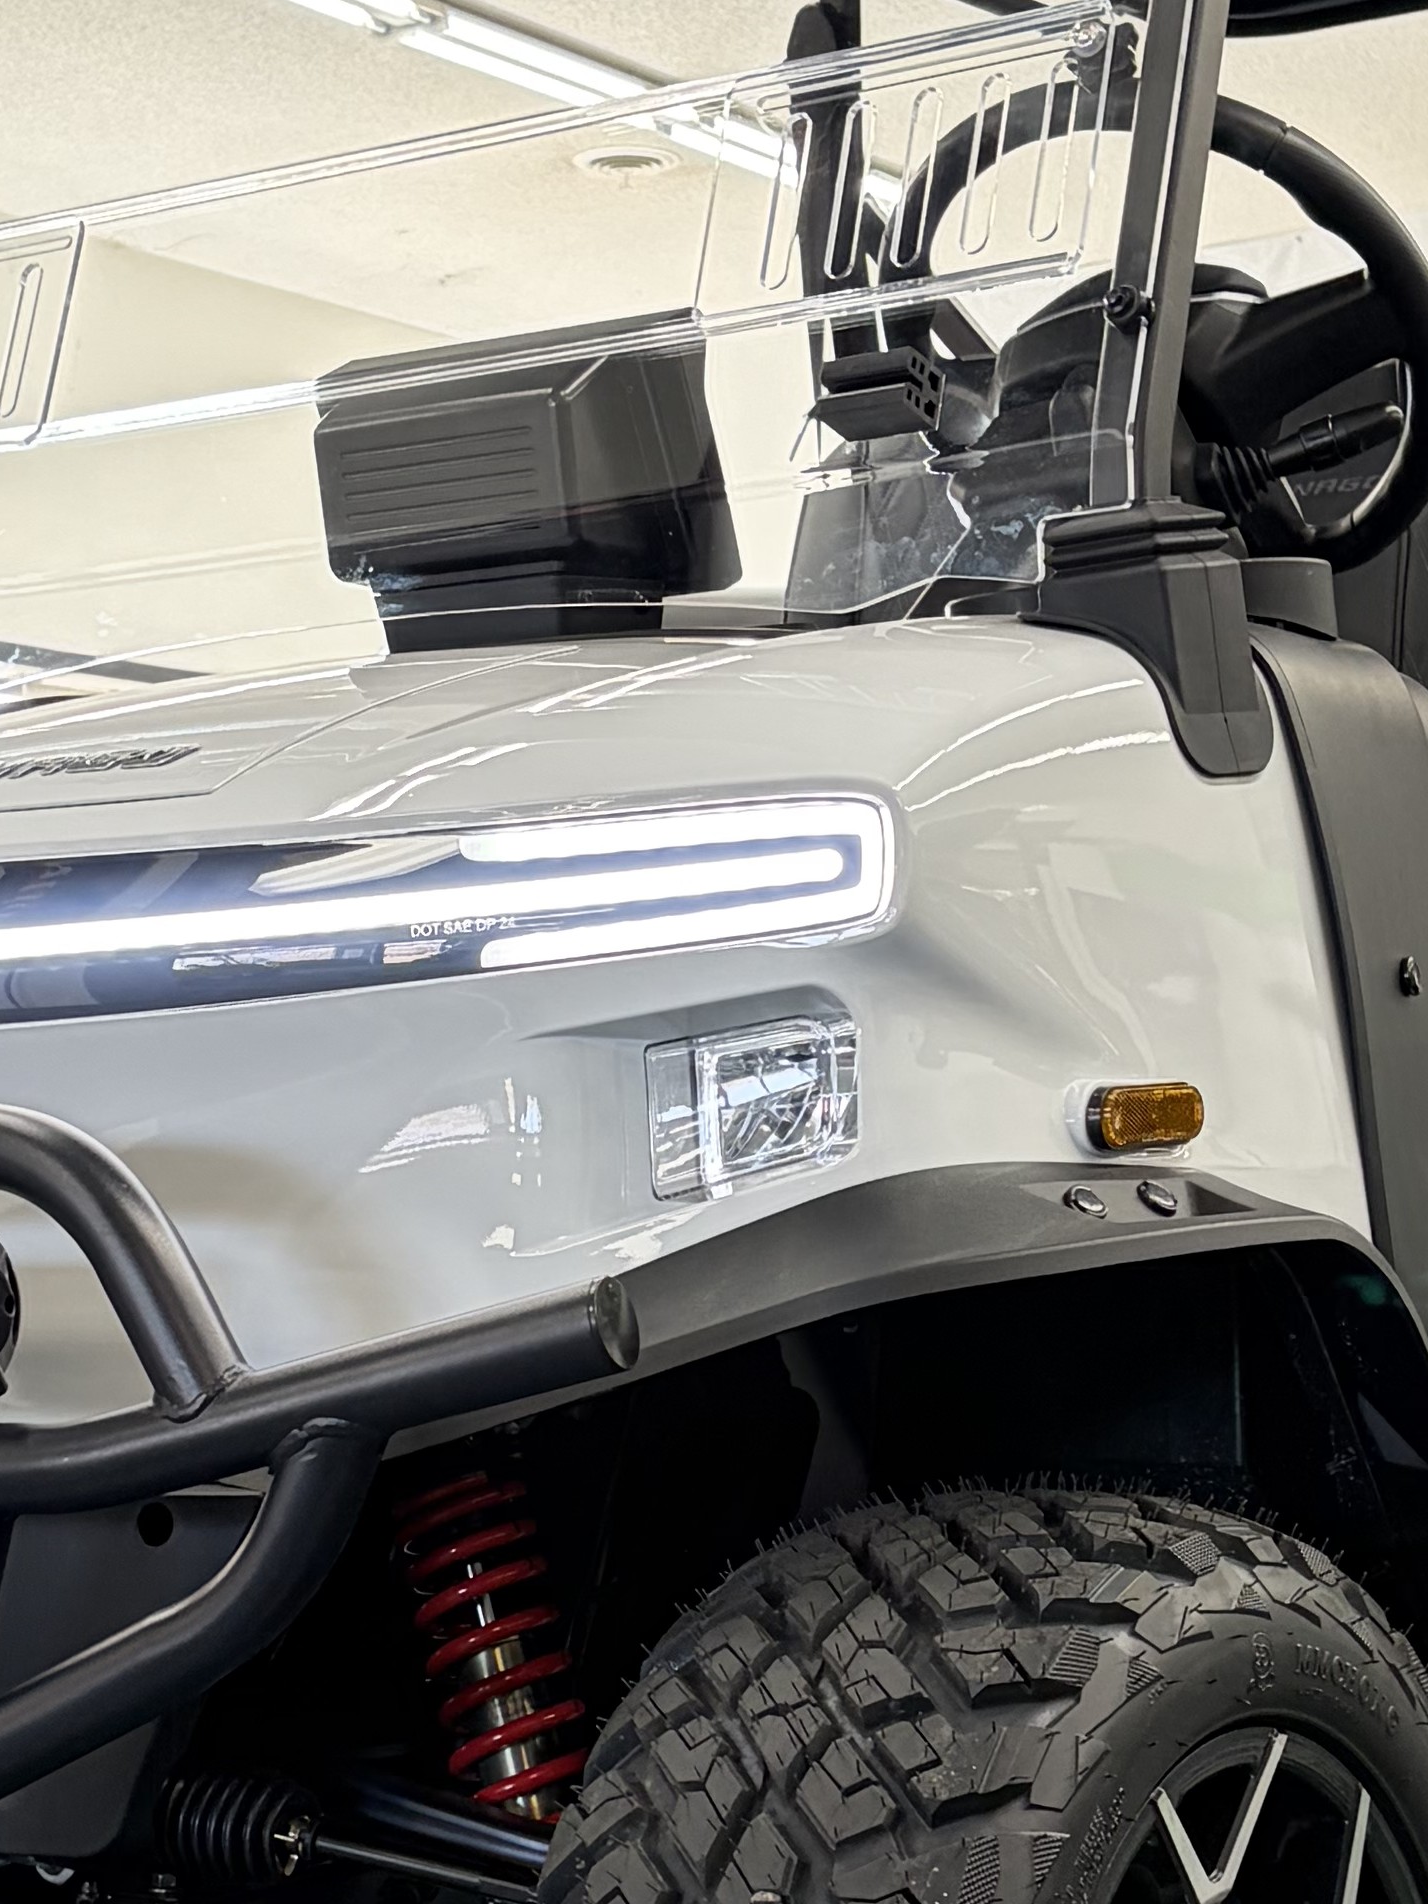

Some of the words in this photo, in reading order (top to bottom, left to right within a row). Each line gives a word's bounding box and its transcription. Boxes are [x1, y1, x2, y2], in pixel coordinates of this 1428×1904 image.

[410, 923, 441, 938] DOT
[443, 919, 473, 935] SAE
[475, 918, 497, 932] DP
